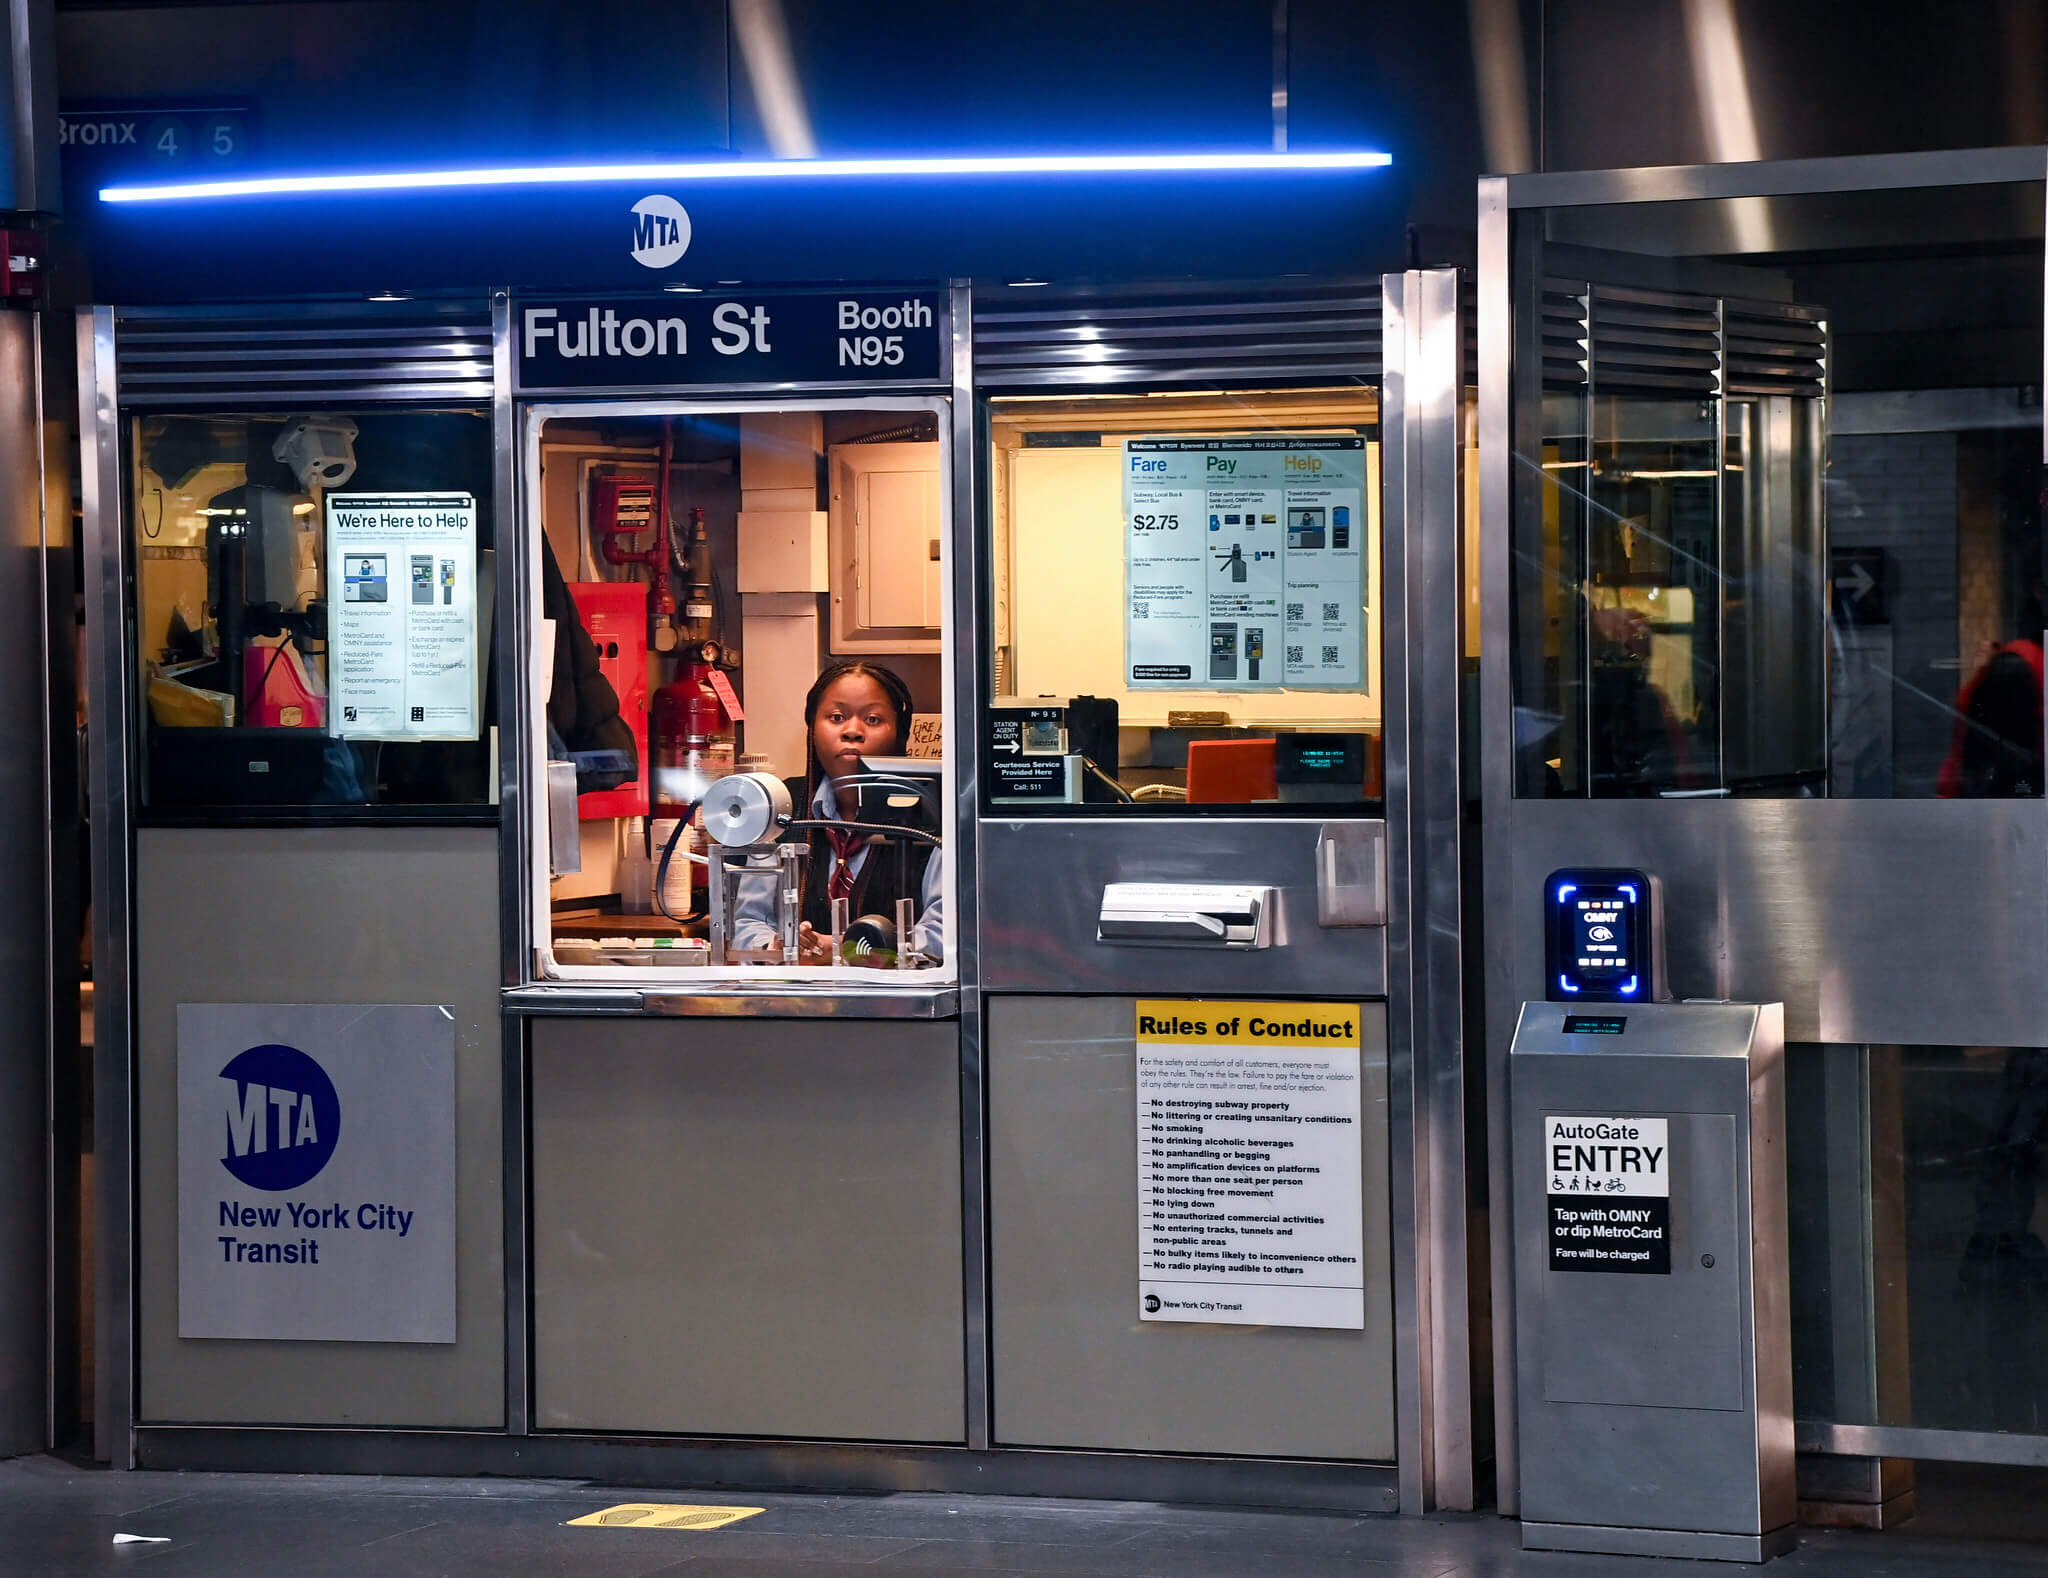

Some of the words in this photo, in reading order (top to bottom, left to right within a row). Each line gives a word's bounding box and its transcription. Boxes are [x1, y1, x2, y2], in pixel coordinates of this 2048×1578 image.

[157, 127, 178, 157] 4
[213, 126, 233, 156] 5
[524, 306, 687, 358] Fulton
[712, 302, 771, 355] St
[838, 299, 932, 330] Booth
[838, 335, 905, 366] N95
[1131, 456, 1167, 472] Fare
[1206, 455, 1237, 474] Pay
[1284, 455, 1322, 473] Help
[337, 513, 376, 528] We're
[380, 513, 414, 528] Here
[418, 514, 433, 528] to
[436, 513, 468, 530] Help
[1134, 514, 1178, 531] $2.75
[1139, 1016, 1207, 1035] Rules
[1216, 1017, 1240, 1036] of
[1248, 1018, 1352, 1038] Conduct
[1140, 1057, 1151, 1066] For
[1165, 1099, 1212, 1109] destroying
[1214, 1100, 1249, 1110] subway
[1251, 1102, 1289, 1111] property
[1151, 1111, 1163, 1119] No
[1166, 1112, 1201, 1122] littering
[1214, 1113, 1252, 1123] creating
[1254, 1114, 1302, 1124] unsanitary
[1304, 1116, 1352, 1124] conditions
[1166, 1124, 1203, 1134] smoking
[1553, 1122, 1639, 1140] AutoGate
[1151, 1136, 1164, 1144] No
[1166, 1136, 1202, 1147] drinking
[1204, 1138, 1245, 1146] alcoholic
[1247, 1139, 1294, 1149] beverages
[1166, 1149, 1220, 1160] panhandling
[1234, 1151, 1270, 1161] begging
[1553, 1144, 1664, 1173] ENTRY
[1166, 1162, 1224, 1171] amplification
[1226, 1163, 1261, 1171] devices
[1277, 1165, 1320, 1173] platforms
[1254, 1178, 1270, 1186] per
[1152, 1186, 1164, 1194] No
[1166, 1187, 1204, 1197] blocking
[1206, 1188, 1225, 1196] free
[1167, 1199, 1188, 1208] lying
[1190, 1200, 1215, 1208] down
[218, 1201, 281, 1228] New
[286, 1201, 350, 1229] York
[357, 1203, 413, 1237] City
[1152, 1211, 1165, 1219] No
[1167, 1212, 1224, 1220] unauthorized
[1282, 1215, 1324, 1224] activities
[1554, 1208, 1578, 1223] Tap
[1580, 1209, 1607, 1222] with
[1609, 1209, 1652, 1223] OMNY
[1153, 1223, 1165, 1231] No
[1167, 1225, 1204, 1234] entering
[1206, 1226, 1238, 1234] tracks,
[1240, 1227, 1274, 1235] tunnels
[1555, 1226, 1569, 1237] or
[1570, 1225, 1591, 1239] dip
[1593, 1225, 1662, 1239] MetroCard
[1153, 1237, 1199, 1246] non-public
[218, 1236, 319, 1264] Transit
[1168, 1249, 1192, 1259] bulky
[1194, 1250, 1220, 1258] items
[1221, 1251, 1246, 1261] likely
[1248, 1252, 1258, 1260] to
[1260, 1252, 1325, 1262] inconvenience
[1327, 1255, 1356, 1263] others
[1556, 1248, 1577, 1258] Fare
[1579, 1249, 1595, 1258] will
[1596, 1249, 1608, 1259] be
[1609, 1250, 1650, 1261] charged
[1153, 1261, 1166, 1269] No
[1168, 1262, 1191, 1270] radio
[1193, 1263, 1225, 1272] playing
[1228, 1264, 1261, 1272] audible
[1163, 1300, 1180, 1308] New
[1181, 1301, 1198, 1309] York
[1199, 1302, 1215, 1311] City
[1215, 1302, 1242, 1310] Transit
